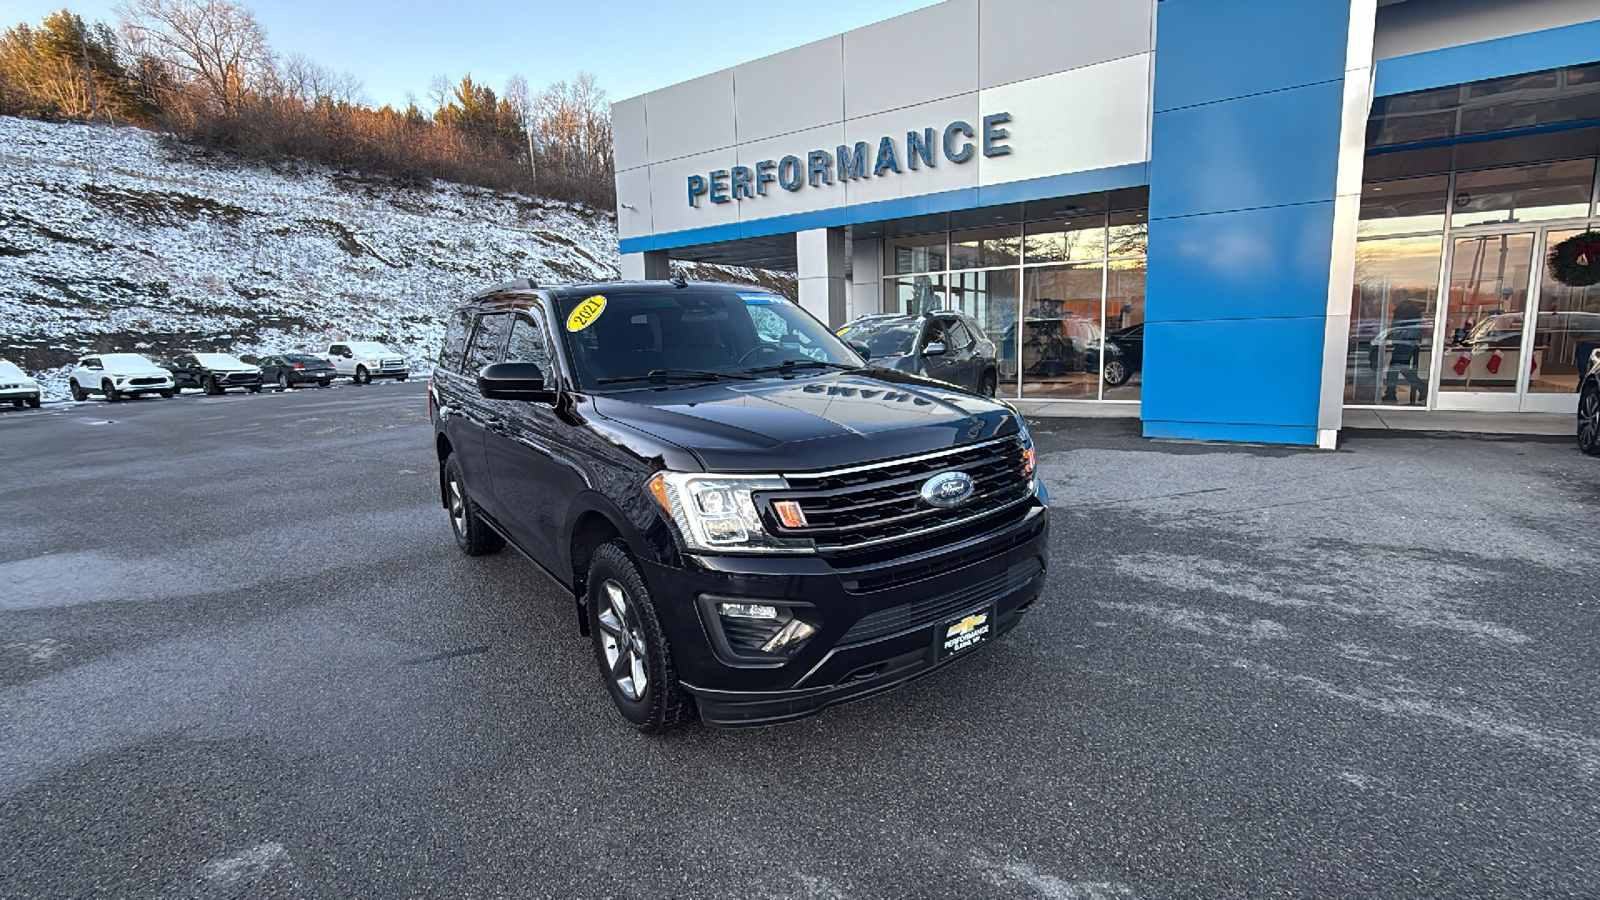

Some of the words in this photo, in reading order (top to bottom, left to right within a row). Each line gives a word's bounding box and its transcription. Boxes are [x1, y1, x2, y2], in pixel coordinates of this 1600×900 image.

[687, 112, 1013, 208] PERFORMANCE
[573, 299, 602, 326] 2021
[940, 480, 966, 498] Ford
[944, 624, 990, 650] PERFORMANCE
